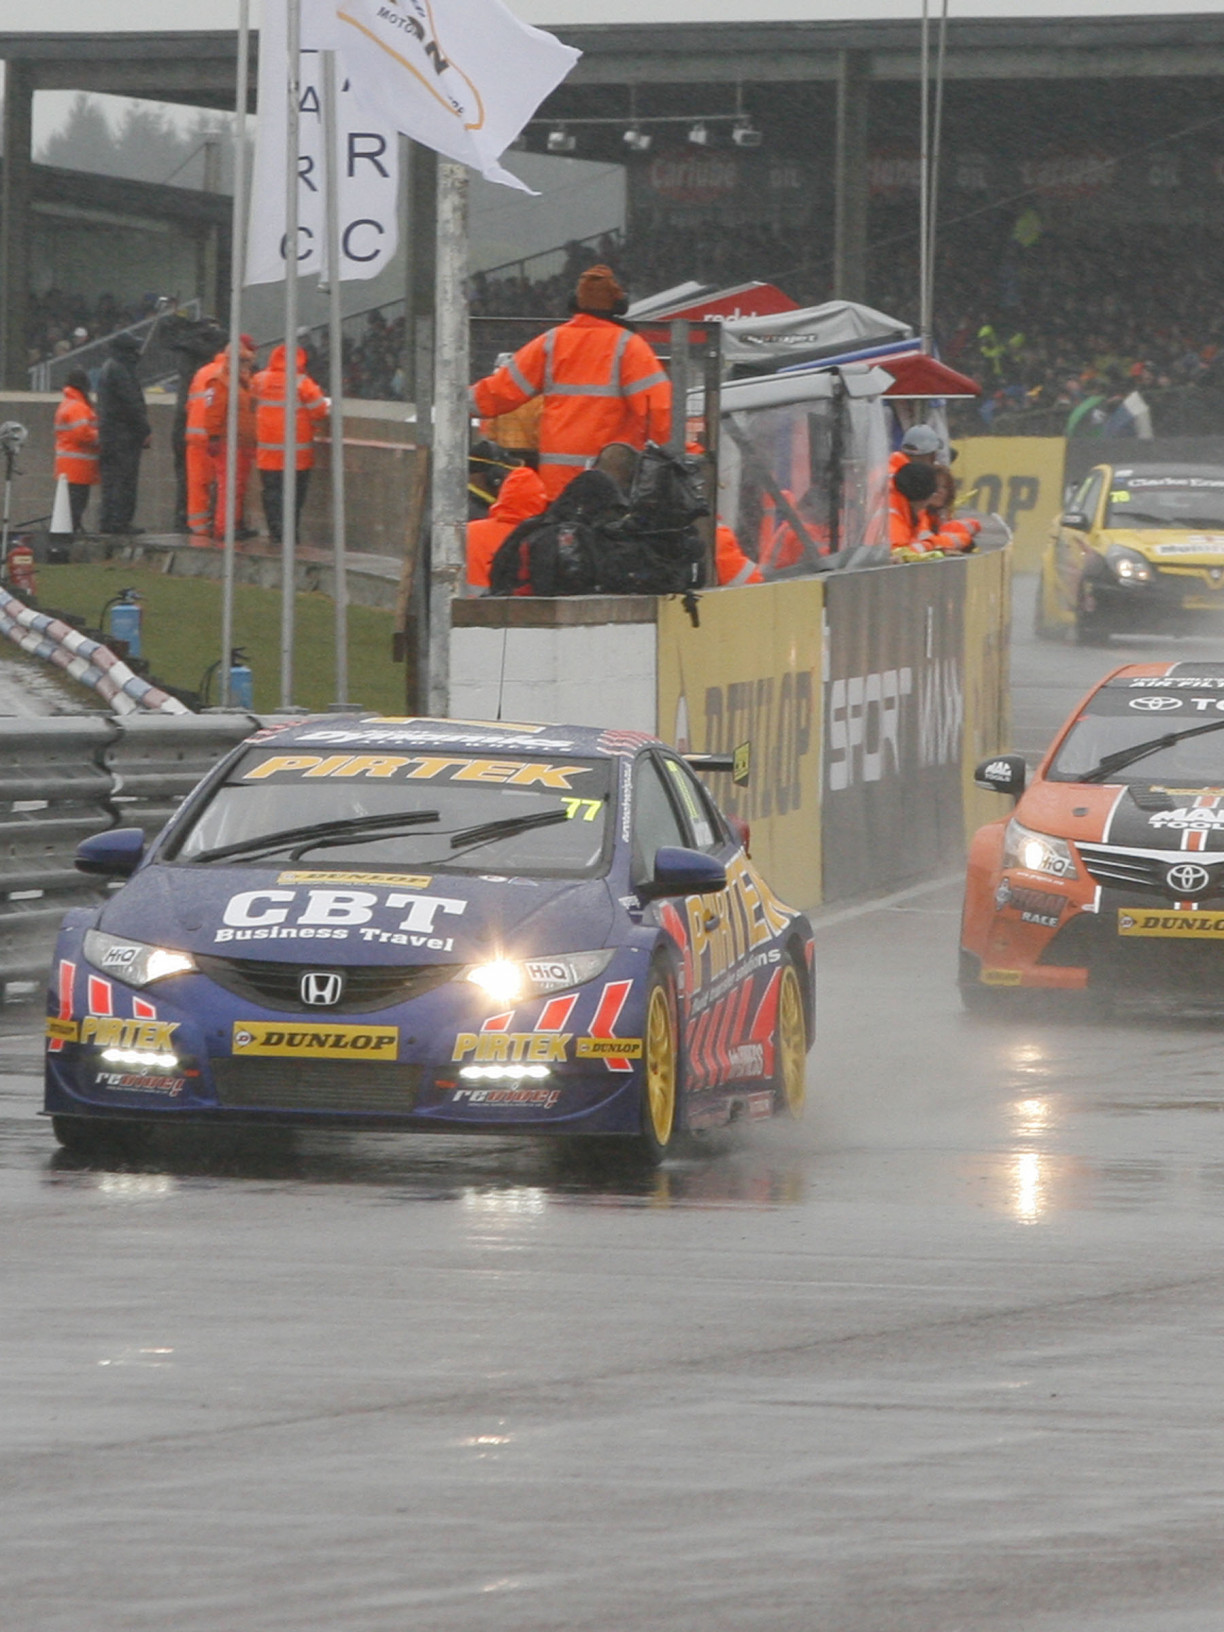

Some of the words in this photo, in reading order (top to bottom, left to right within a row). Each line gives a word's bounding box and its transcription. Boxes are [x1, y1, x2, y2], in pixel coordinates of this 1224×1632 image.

[242, 755, 594, 790] PIRTEK
[560, 797, 603, 821] 77
[222, 889, 468, 934] CBT
[1021, 911, 1059, 927] RACE
[214, 926, 350, 943] Business
[359, 927, 455, 952] Travel
[106, 949, 136, 963] HiQ
[528, 964, 567, 981] HiQ
[81, 1016, 182, 1051] PIRTEK
[260, 1031, 397, 1051] DUNLOP
[451, 1032, 575, 1063] PIRTEK
[591, 1042, 641, 1053] DUNLOP
